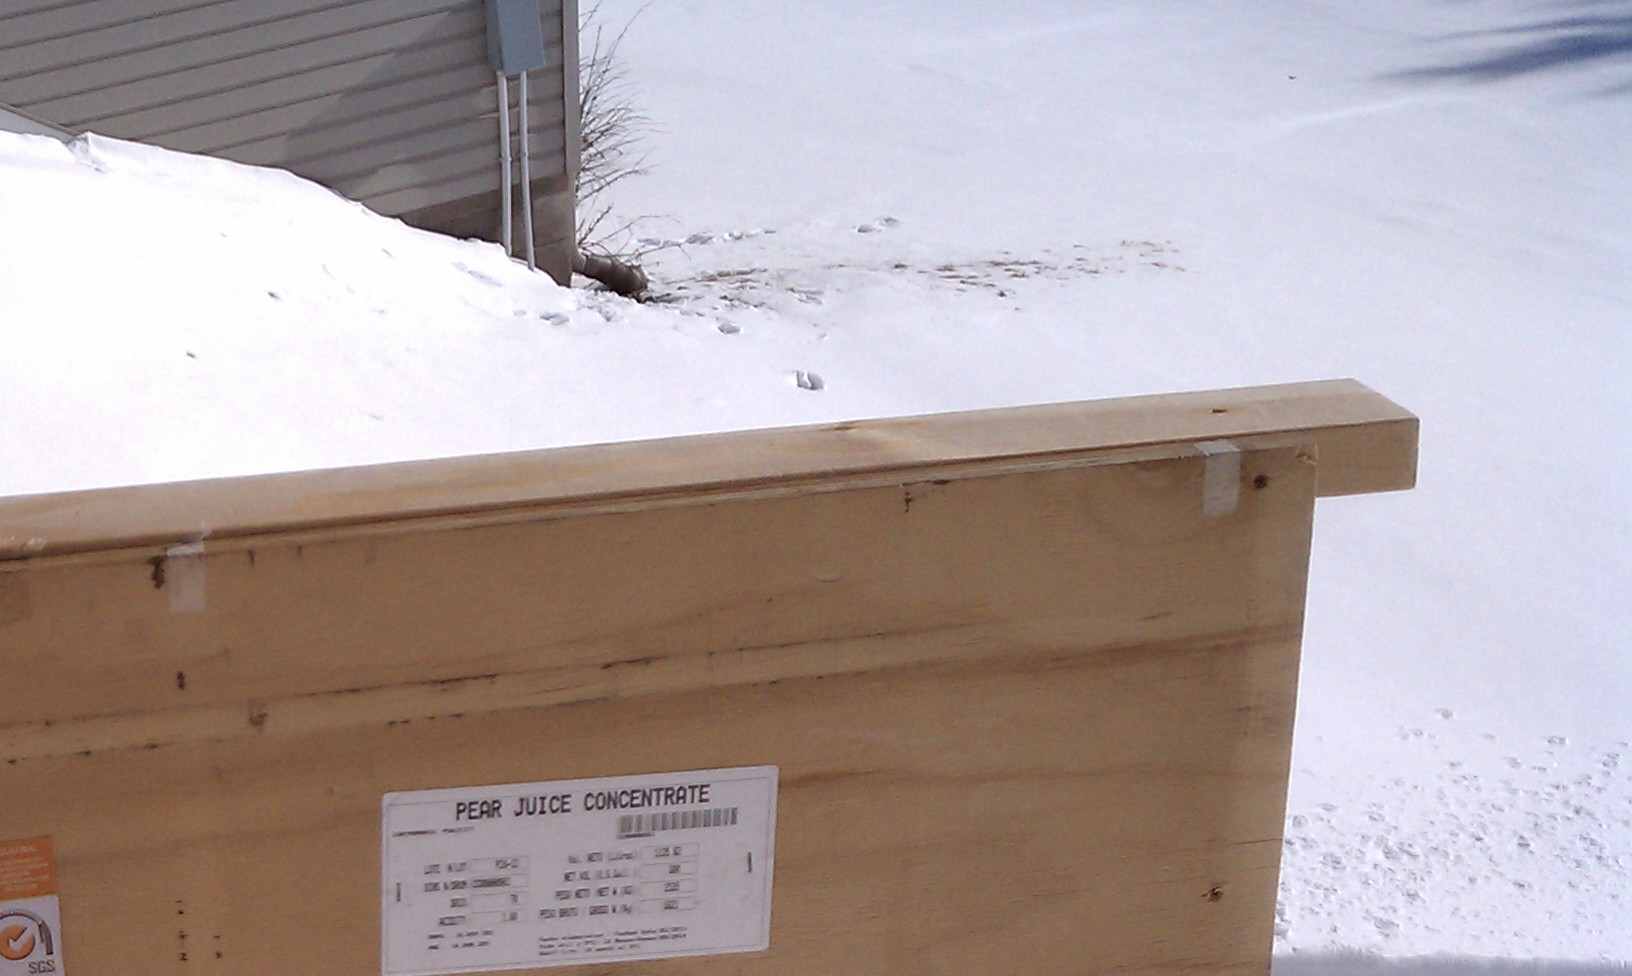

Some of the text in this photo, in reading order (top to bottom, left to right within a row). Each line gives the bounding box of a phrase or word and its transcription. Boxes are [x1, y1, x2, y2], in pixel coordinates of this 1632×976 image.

[456, 784, 711, 821] PEAR JUICE CONCENTRATE
[29, 959, 55, 974] SGS
